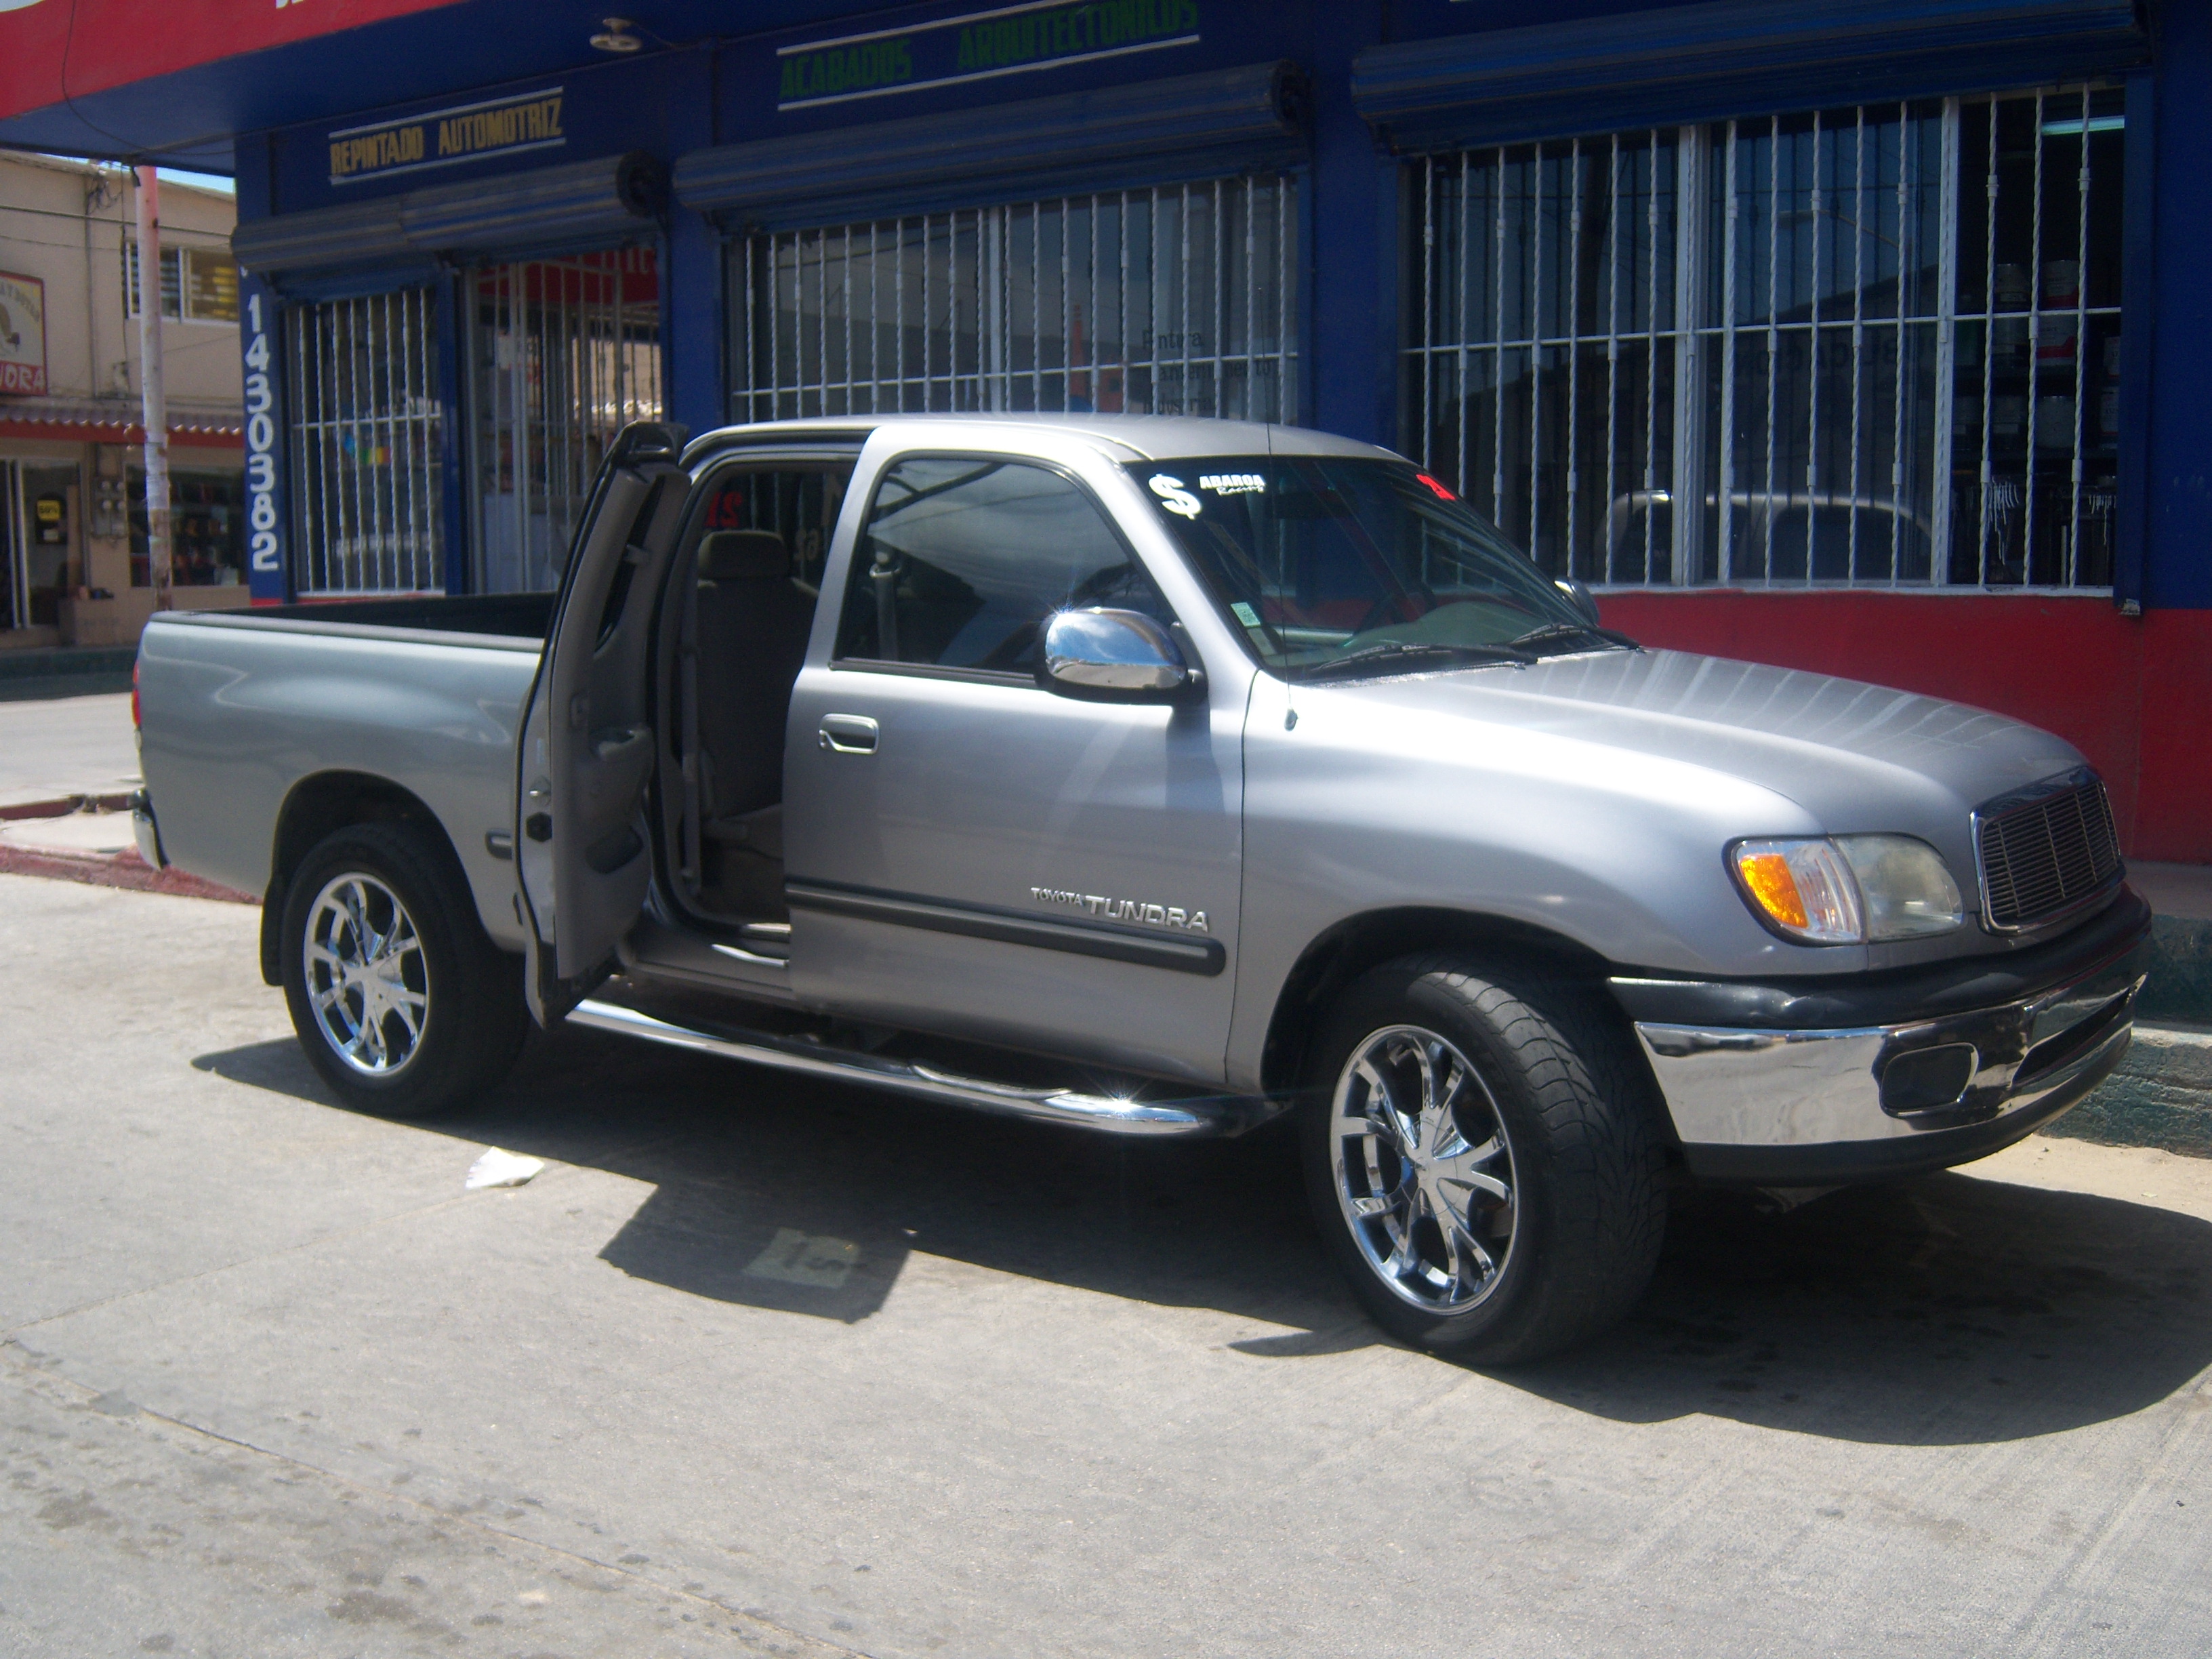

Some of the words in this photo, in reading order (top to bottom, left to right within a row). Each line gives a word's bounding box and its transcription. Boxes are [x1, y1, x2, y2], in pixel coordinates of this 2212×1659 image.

[778, 38, 913, 99] ACABADOS
[329, 127, 424, 176] REPINTADO
[438, 97, 563, 156] AUTOMOTRIZ
[0, 363, 45, 392] ORA
[1199, 474, 1266, 490] ABAROA
[1216, 485, 1266, 496] Racing
[1030, 886, 1084, 907] TOYOTA
[1085, 895, 1208, 933] TUNDRA
